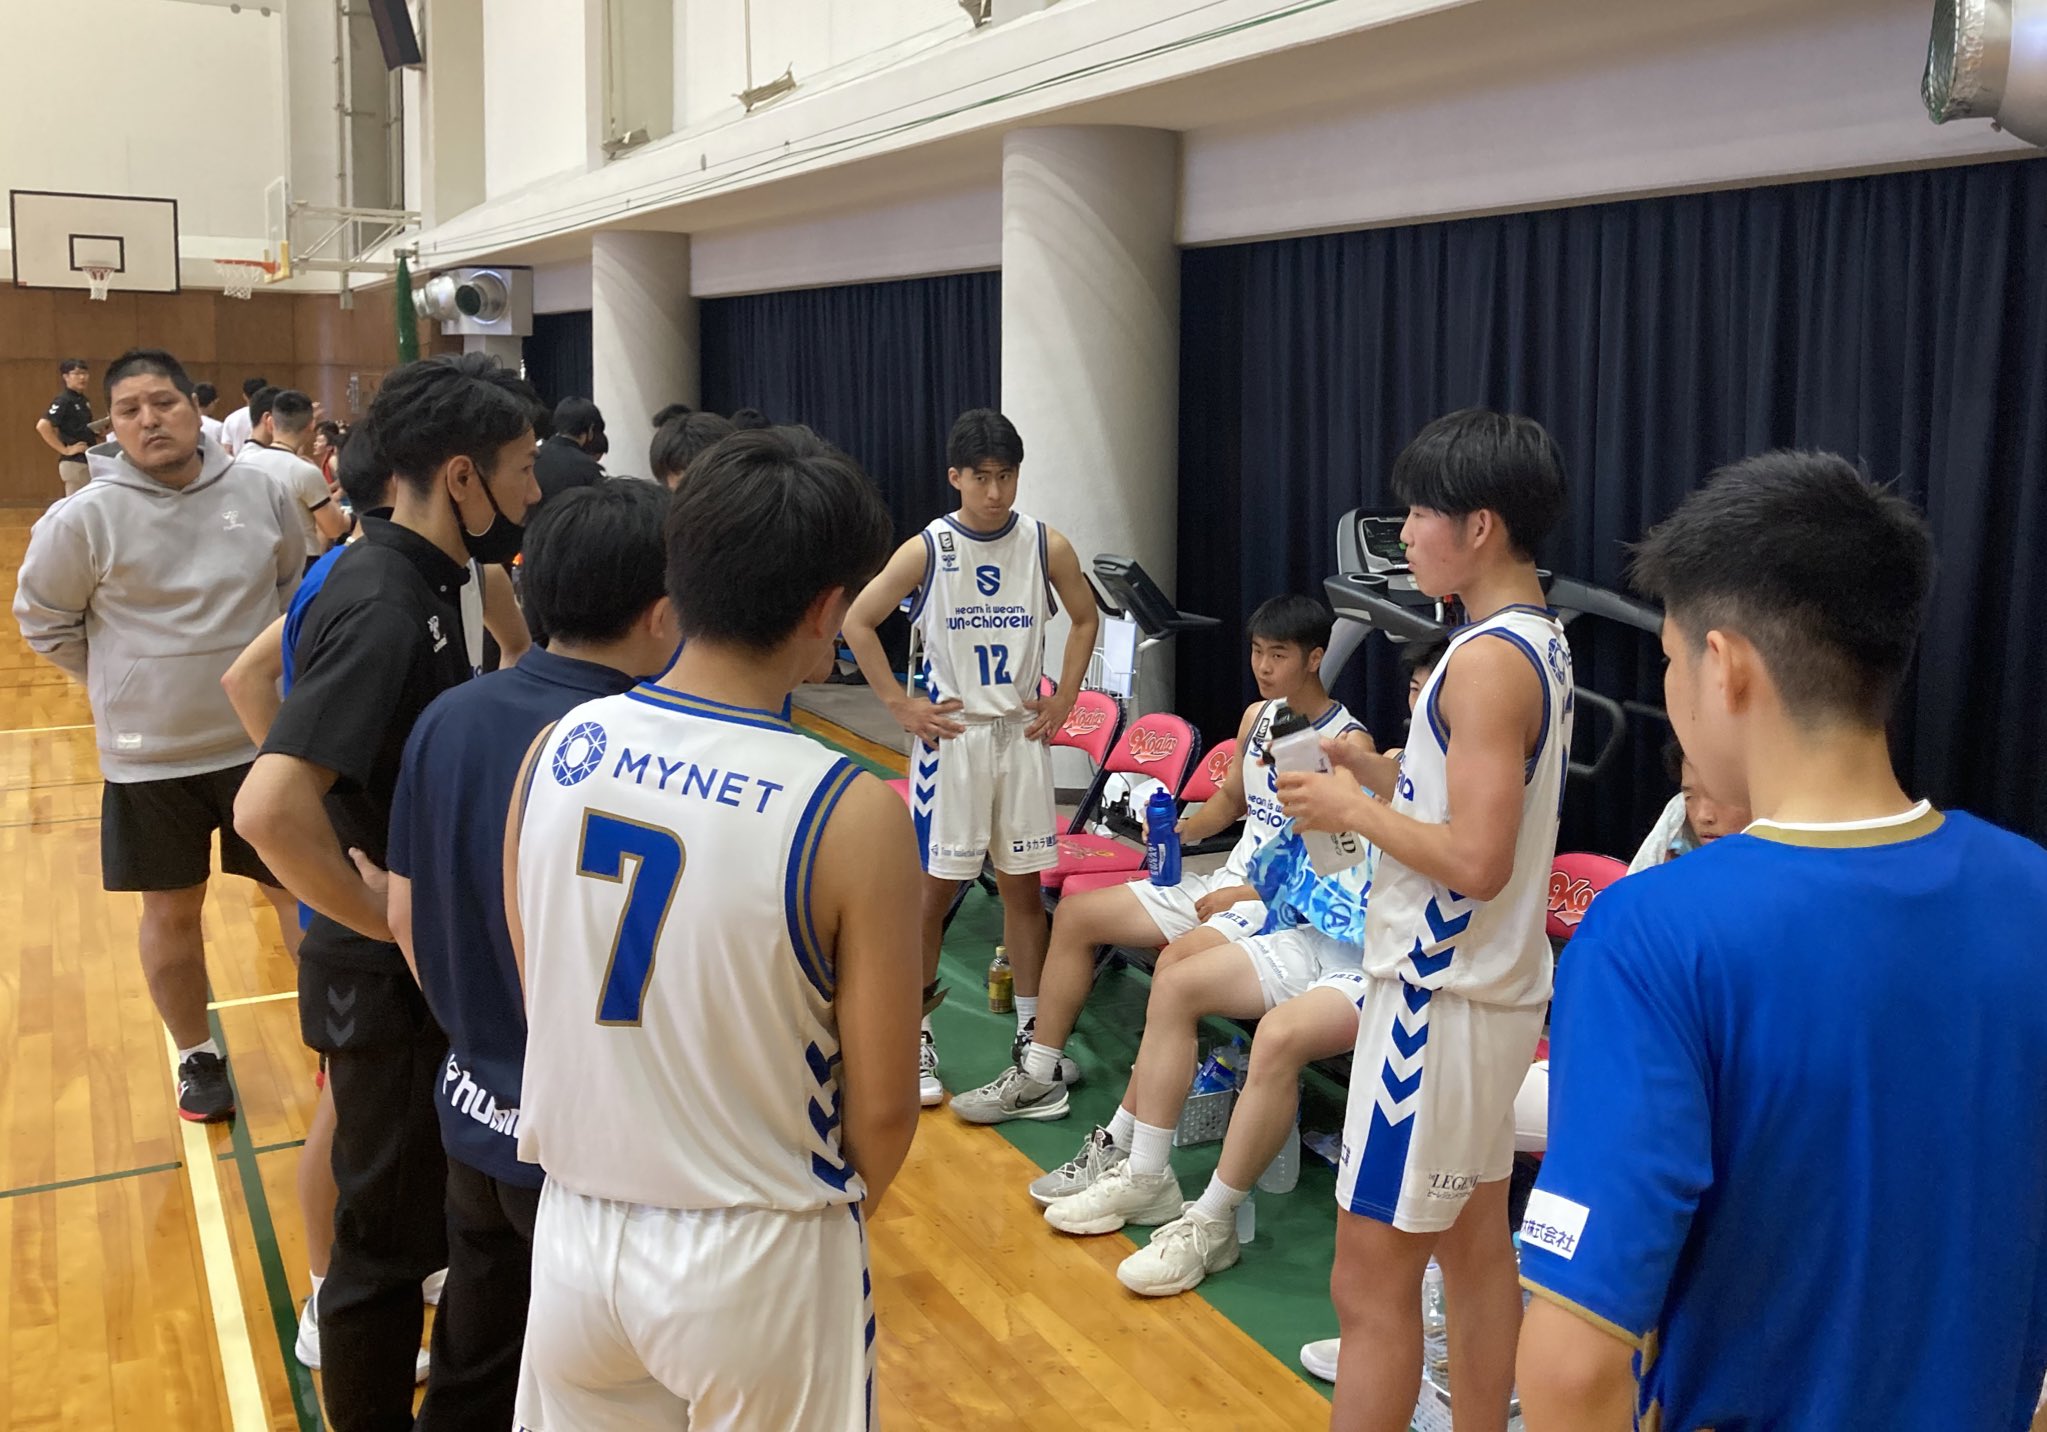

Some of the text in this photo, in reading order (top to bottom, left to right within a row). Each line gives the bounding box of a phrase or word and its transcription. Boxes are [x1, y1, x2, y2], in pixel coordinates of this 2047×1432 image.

[974, 644, 1013, 686] 12
[612, 747, 784, 814] MYNET
[575, 806, 687, 1028] 7
